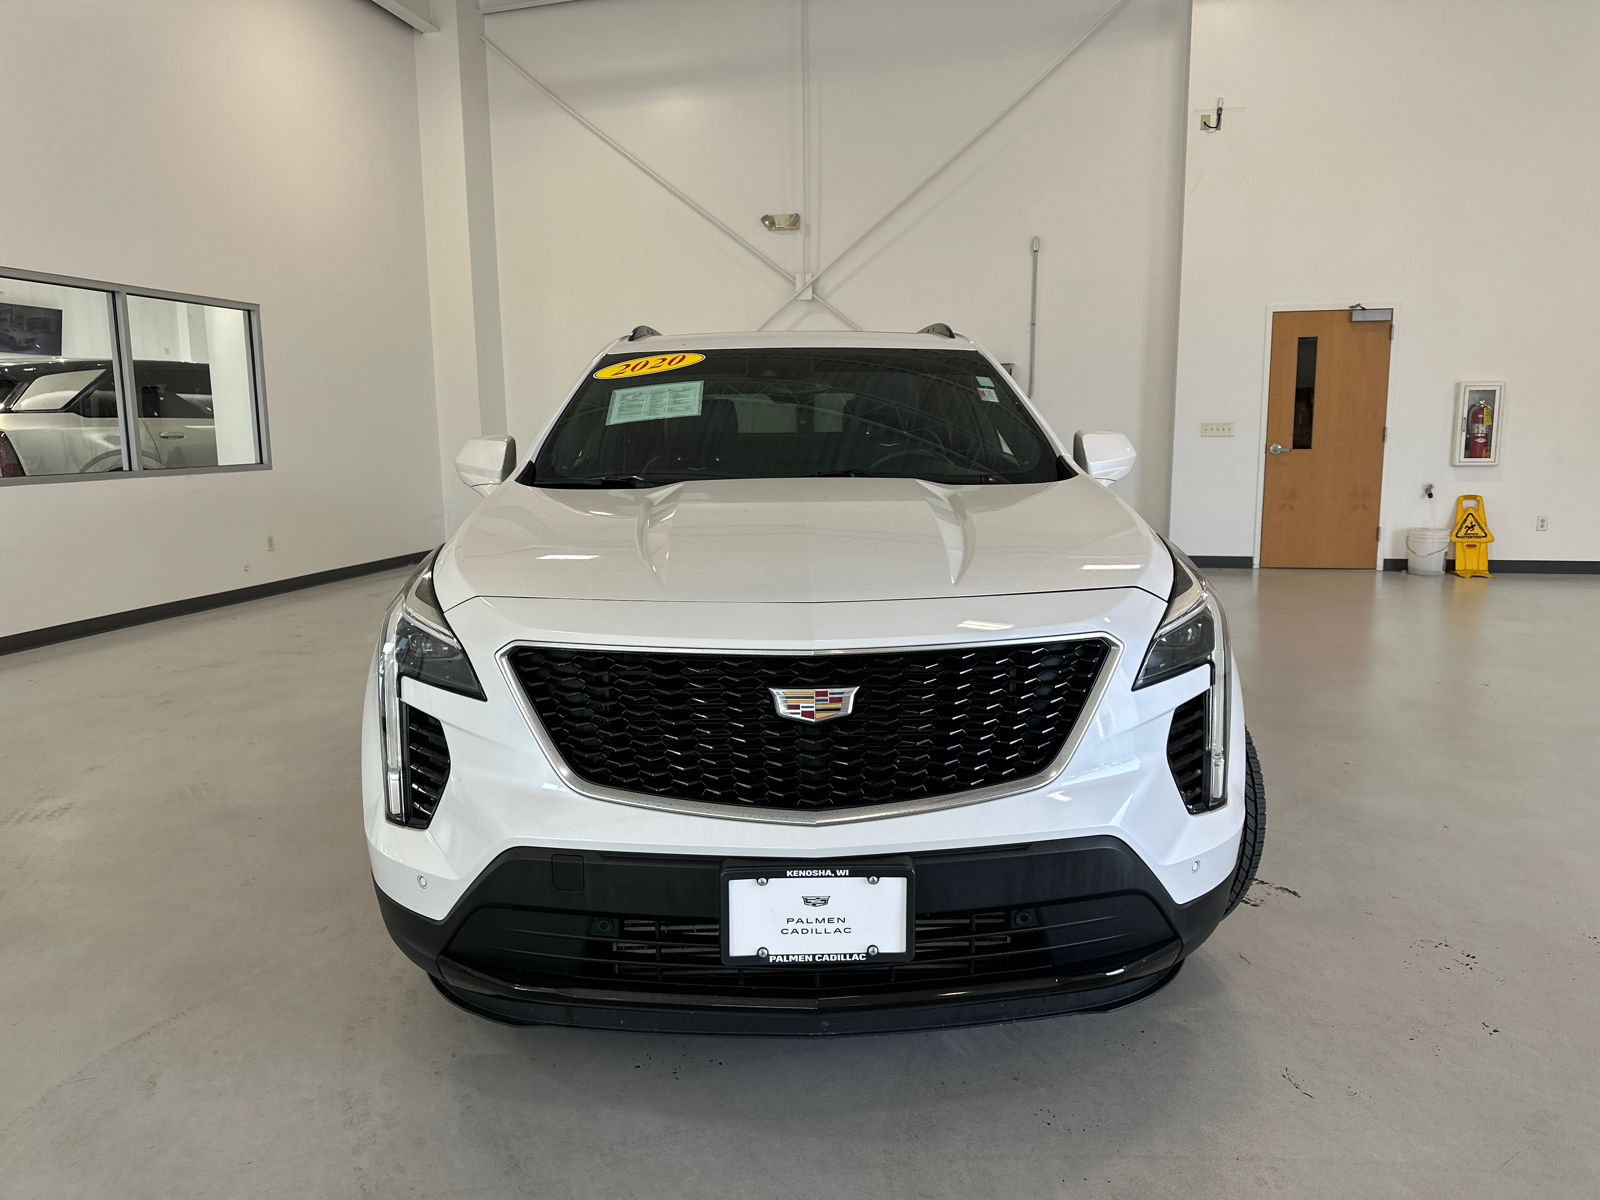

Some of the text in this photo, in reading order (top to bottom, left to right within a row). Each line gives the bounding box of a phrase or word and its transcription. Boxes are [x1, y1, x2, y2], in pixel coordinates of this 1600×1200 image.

[611, 355, 685, 376] 2020
[780, 927, 852, 935] CADILLAC
[769, 954, 867, 963] PALMEN CADILLAC
